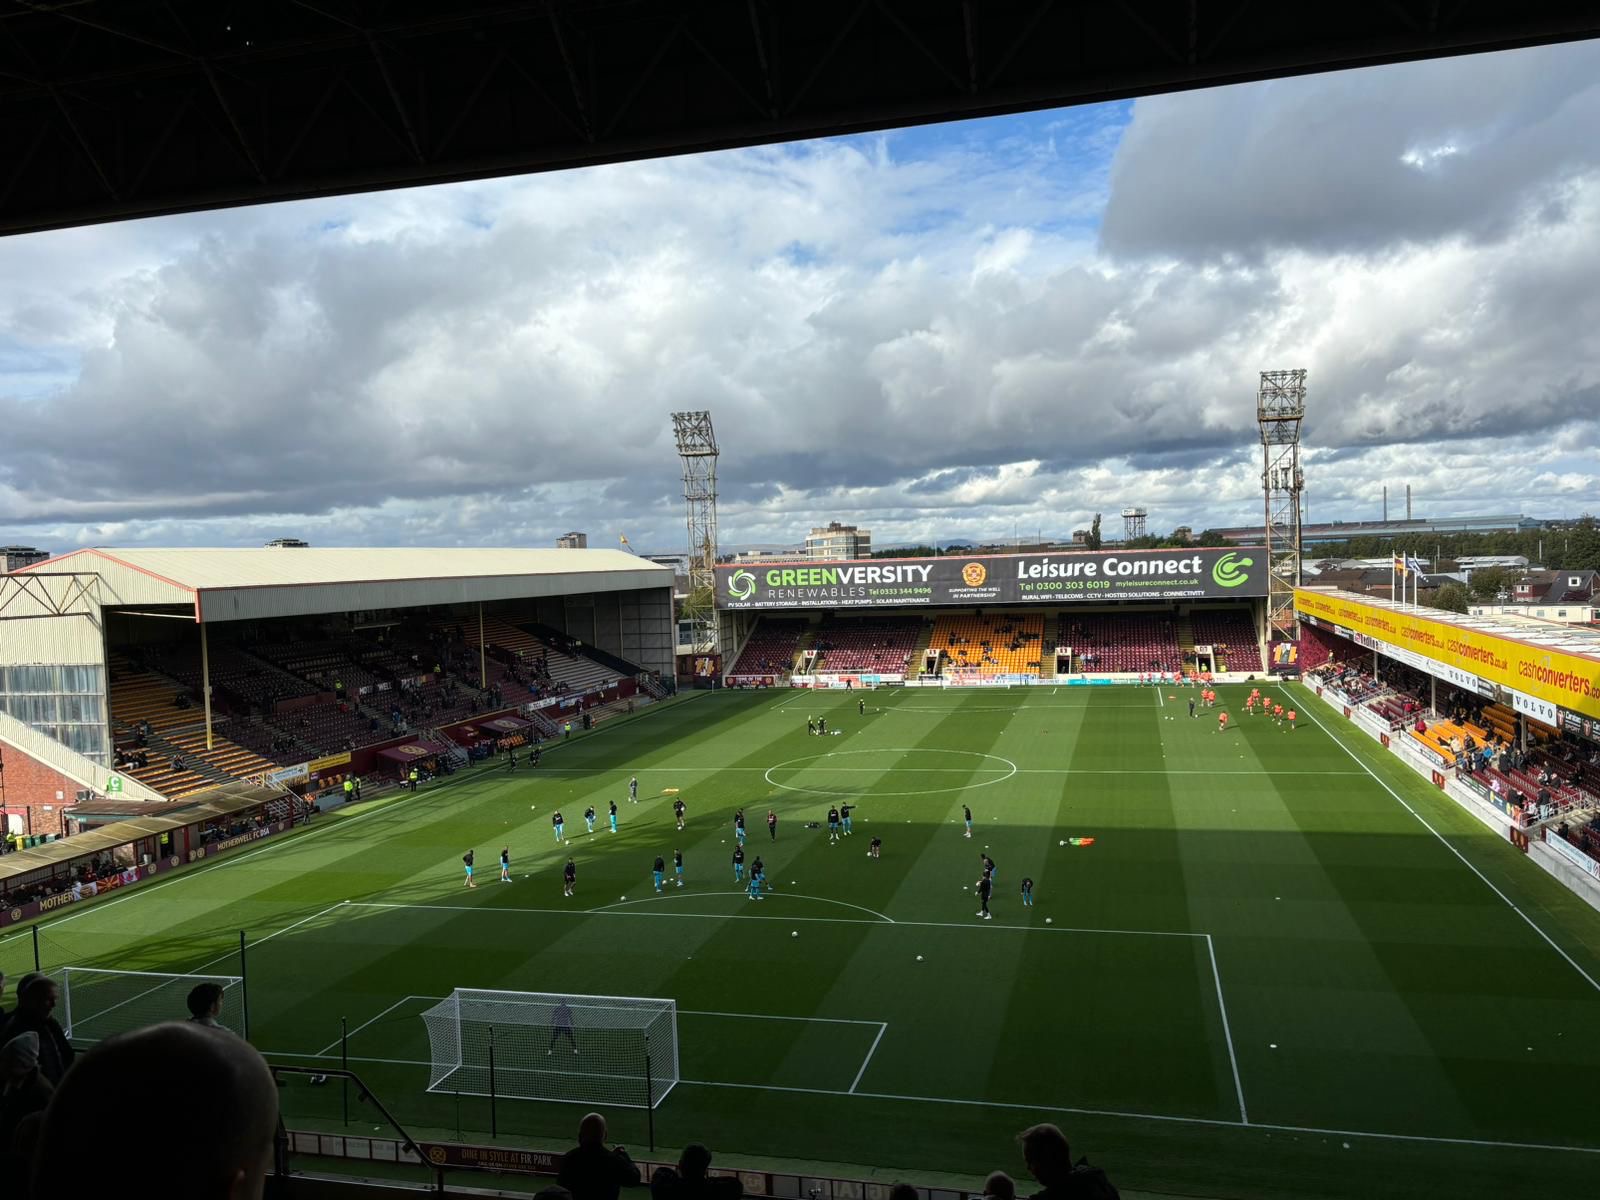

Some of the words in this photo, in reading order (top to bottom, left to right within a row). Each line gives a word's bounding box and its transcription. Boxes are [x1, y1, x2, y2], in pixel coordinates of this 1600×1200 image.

[766, 564, 934, 587] GREENVERSITY
[1017, 558, 1097, 579] Leisure
[1103, 555, 1203, 576] Connect
[768, 586, 865, 599] RENEWABLES
[1019, 583, 1034, 591] Tel
[1036, 582, 1062, 590] 0300
[1065, 581, 1084, 590] 303
[1086, 580, 1111, 589] 6019
[1115, 578, 1199, 588] myleisureconnect.co.uk
[1447, 638, 1508, 670] cashconverters.co.uk
[1448, 669, 1477, 688] VOLVO
[1515, 695, 1554, 719] VOLVO
[217, 833, 252, 851] MOTHERWELL
[253, 830, 260, 839] FC
[489, 1150, 509, 1163] STYLE
[510, 1152, 520, 1163] AT
[520, 1153, 533, 1165] FIR
[533, 1154, 552, 1167] PARK
